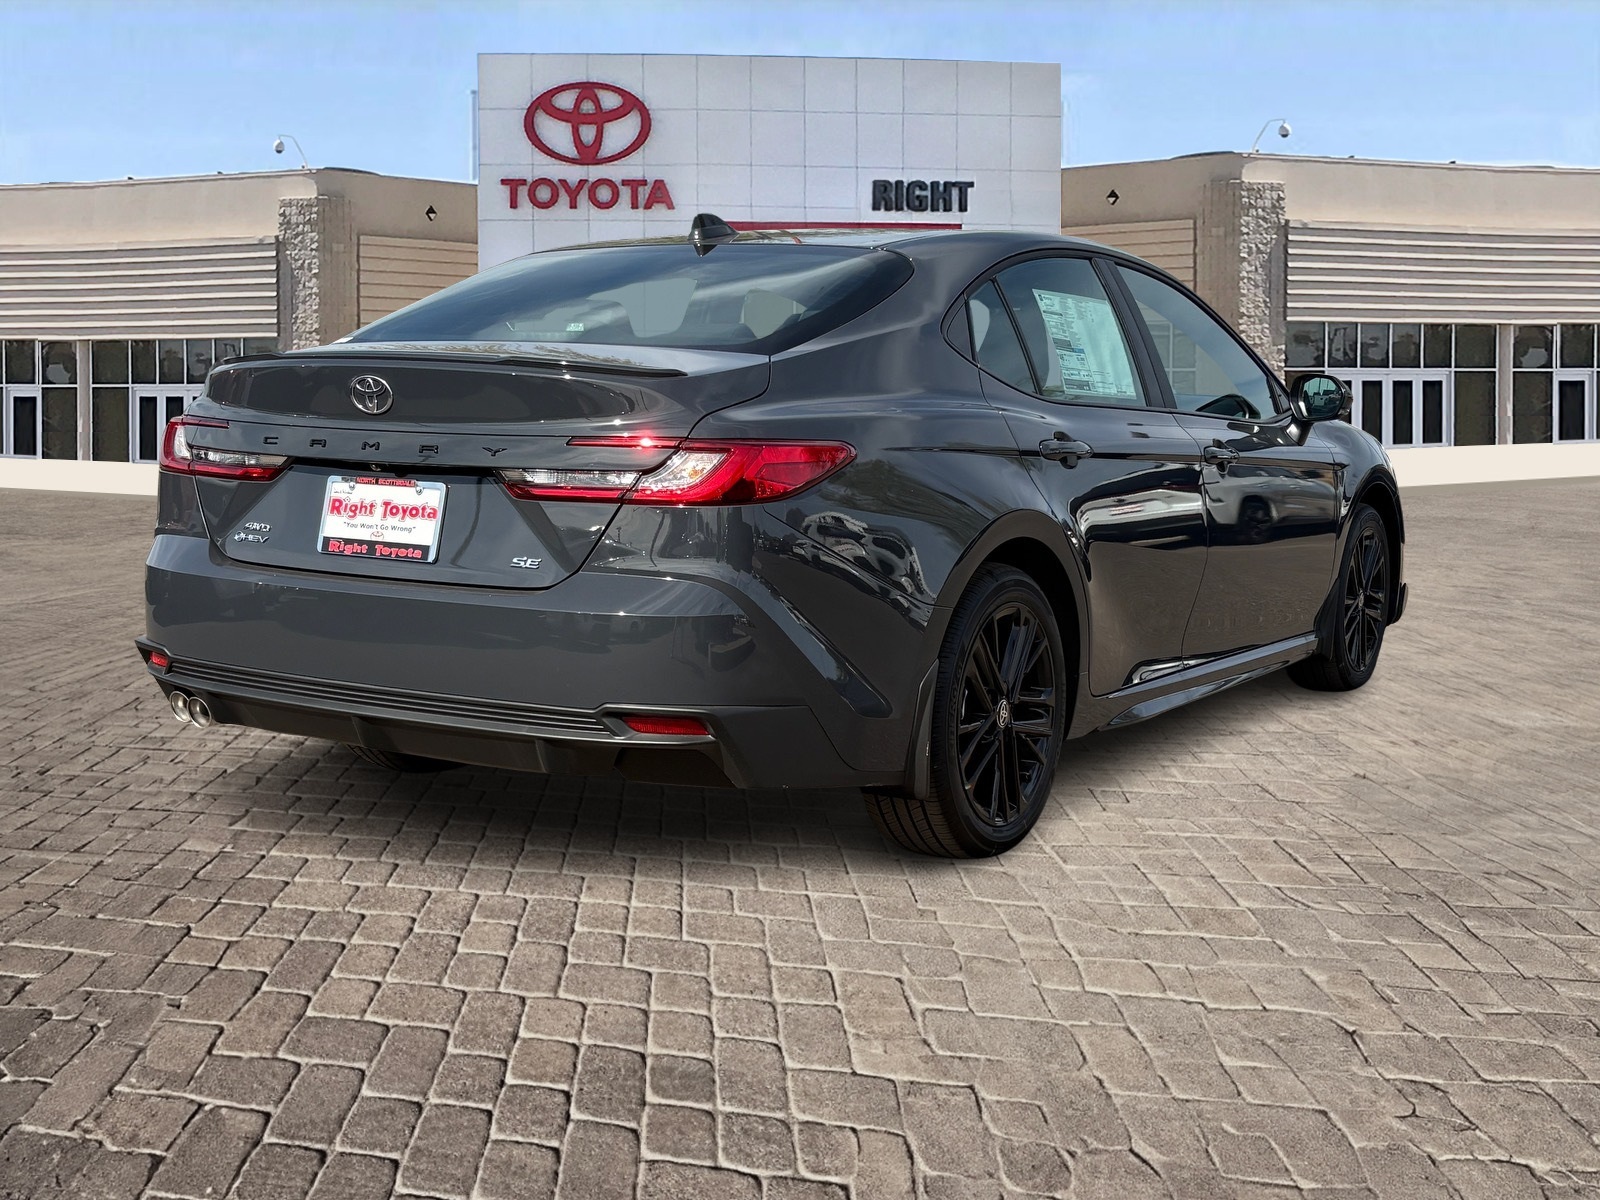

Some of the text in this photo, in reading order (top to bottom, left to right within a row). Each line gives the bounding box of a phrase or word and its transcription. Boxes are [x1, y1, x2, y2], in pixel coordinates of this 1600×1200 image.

[500, 177, 675, 210] TOYOTA
[872, 179, 975, 212] RIGHT
[262, 436, 508, 457] CAMRY
[356, 476, 375, 485] NORTH
[378, 477, 415, 487] SCOTTSDALE
[329, 496, 439, 522] Right Toyota
[360, 522, 378, 530] Won't
[328, 539, 423, 559] Right Toyota
[510, 556, 542, 569] SE
